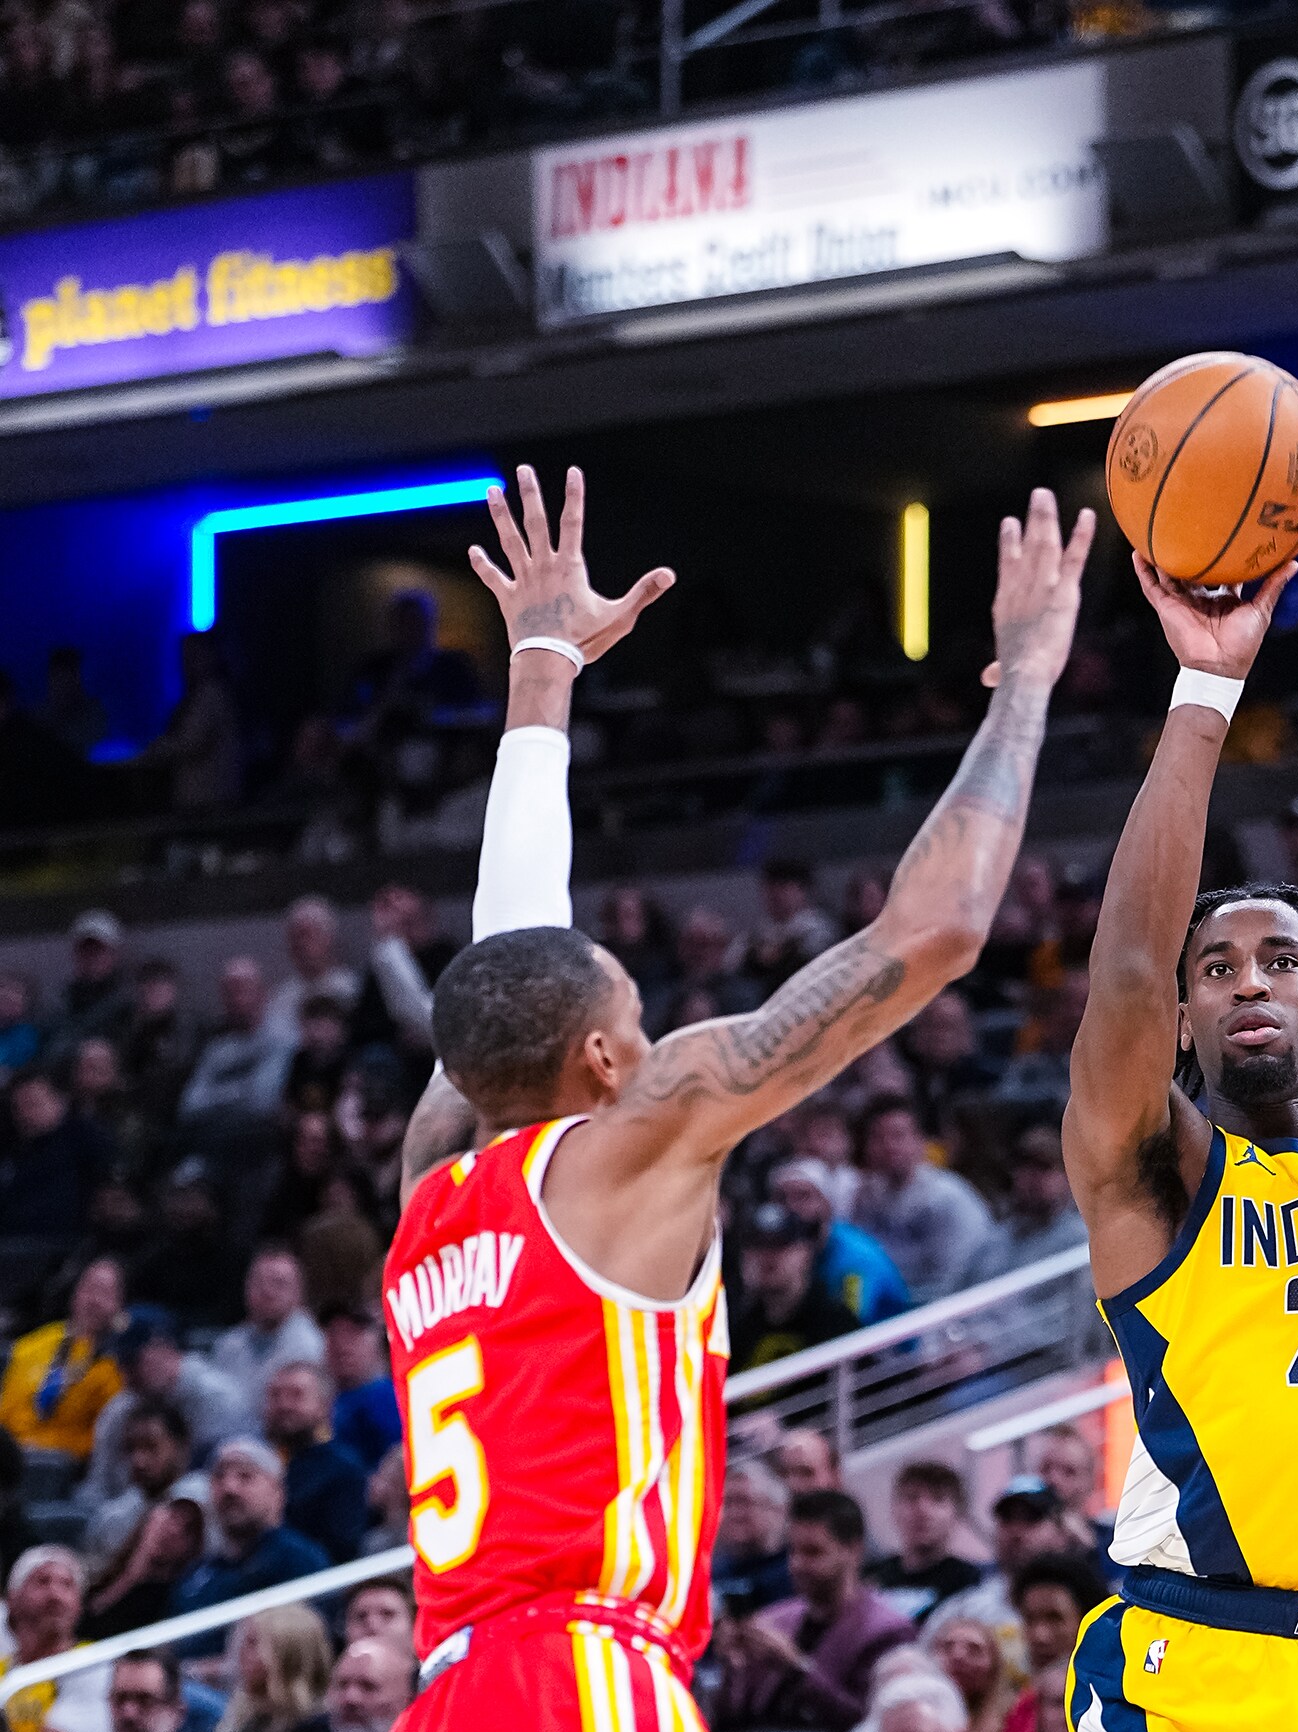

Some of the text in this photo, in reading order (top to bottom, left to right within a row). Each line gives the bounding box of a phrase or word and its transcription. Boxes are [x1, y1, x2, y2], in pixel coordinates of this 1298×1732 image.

[550, 134, 750, 240] INDIANA
[22, 247, 398, 371] planet fitness
[406, 1334, 490, 1576] 5
